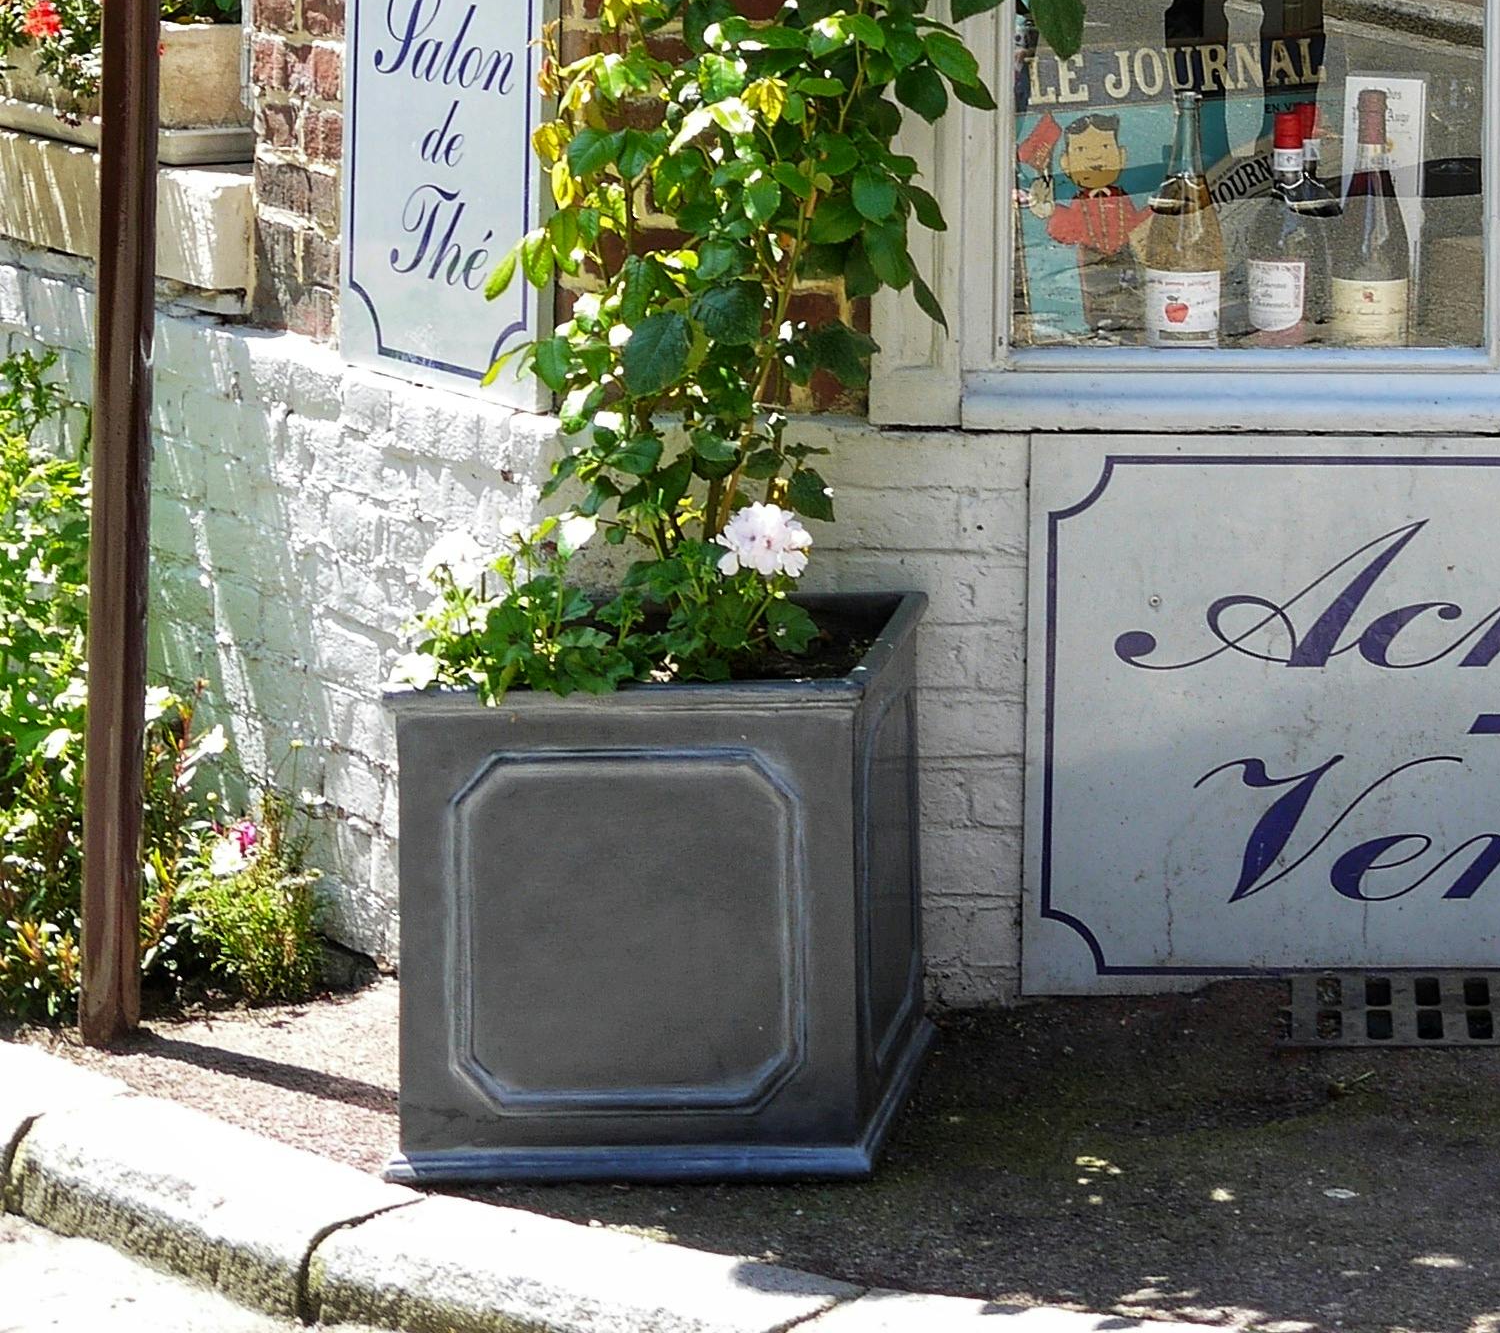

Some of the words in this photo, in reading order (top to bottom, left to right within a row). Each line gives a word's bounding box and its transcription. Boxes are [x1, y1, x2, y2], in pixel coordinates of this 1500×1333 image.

[1027, 55, 1090, 105] LE
[1104, 36, 1328, 99] JOURNAL
[420, 100, 465, 167] de
[1211, 152, 1276, 215] JOURN
[390, 183, 494, 292] Thé
